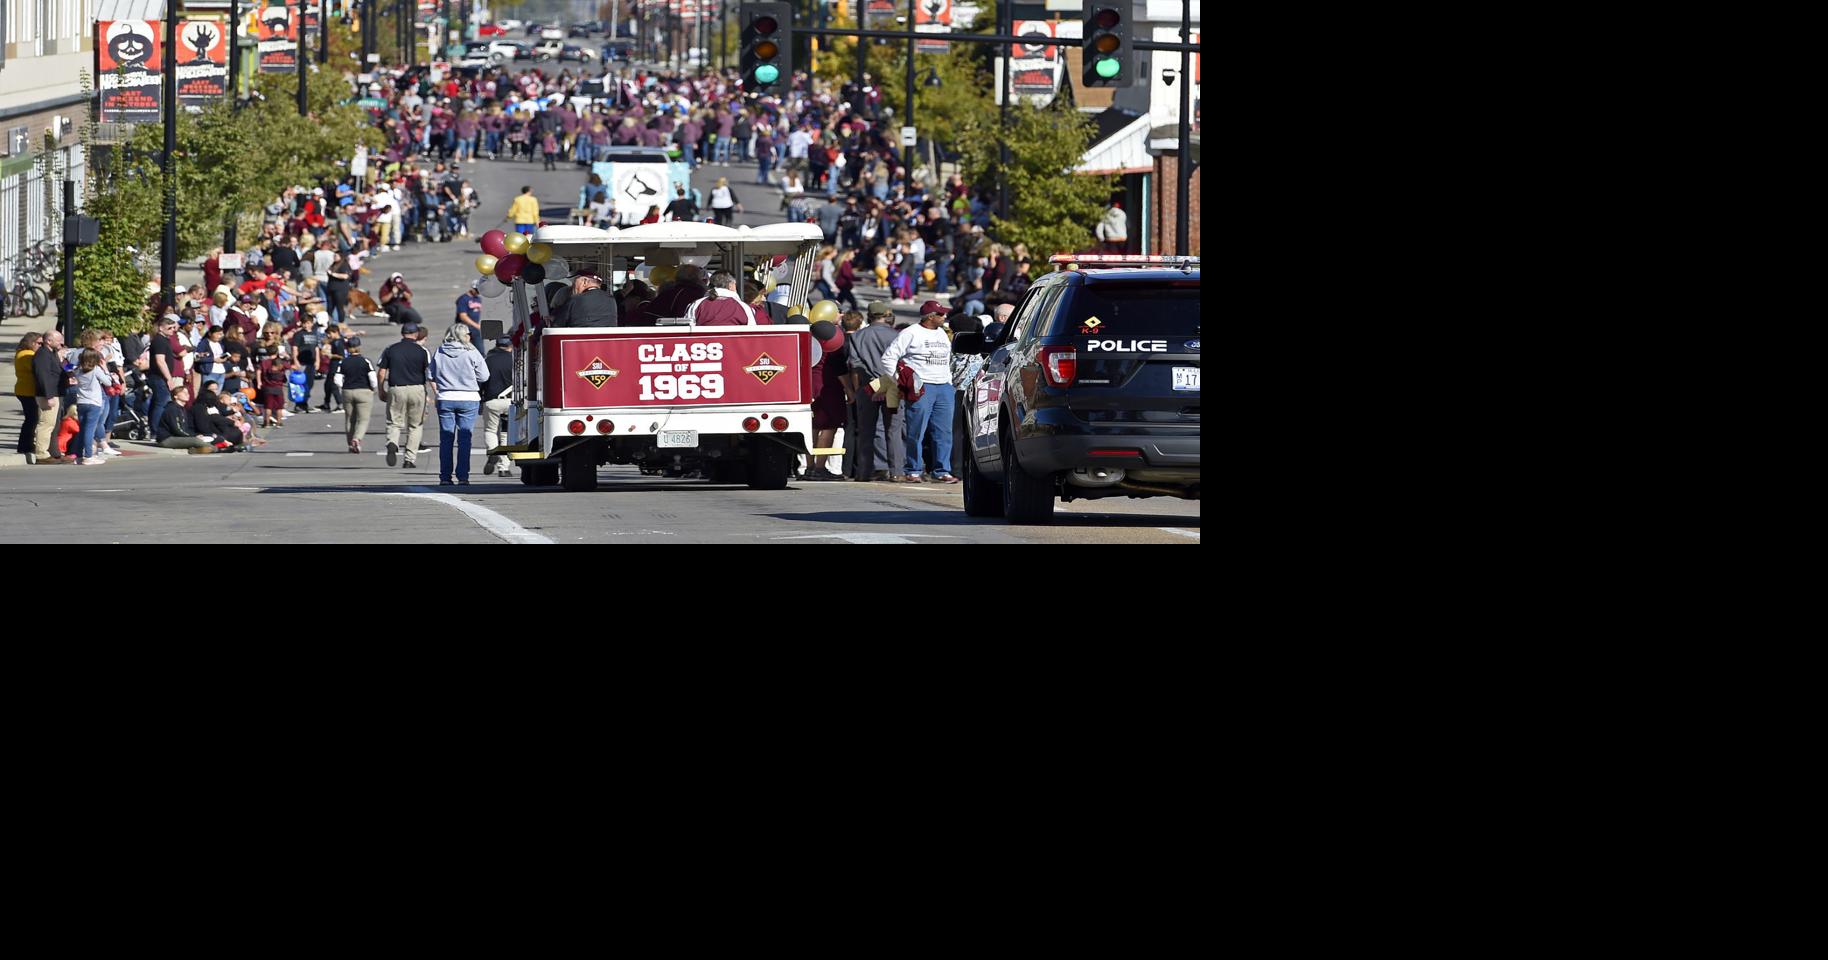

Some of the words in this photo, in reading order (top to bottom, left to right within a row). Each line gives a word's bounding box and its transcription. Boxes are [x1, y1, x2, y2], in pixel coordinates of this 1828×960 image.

[1087, 340, 1168, 352] POLICE
[638, 342, 724, 362] CLASS
[592, 362, 603, 370] SIU
[674, 363, 689, 372] OF
[591, 375, 606, 385] 150
[758, 370, 773, 381] 150
[638, 373, 725, 400] 1969
[663, 434, 669, 444] U
